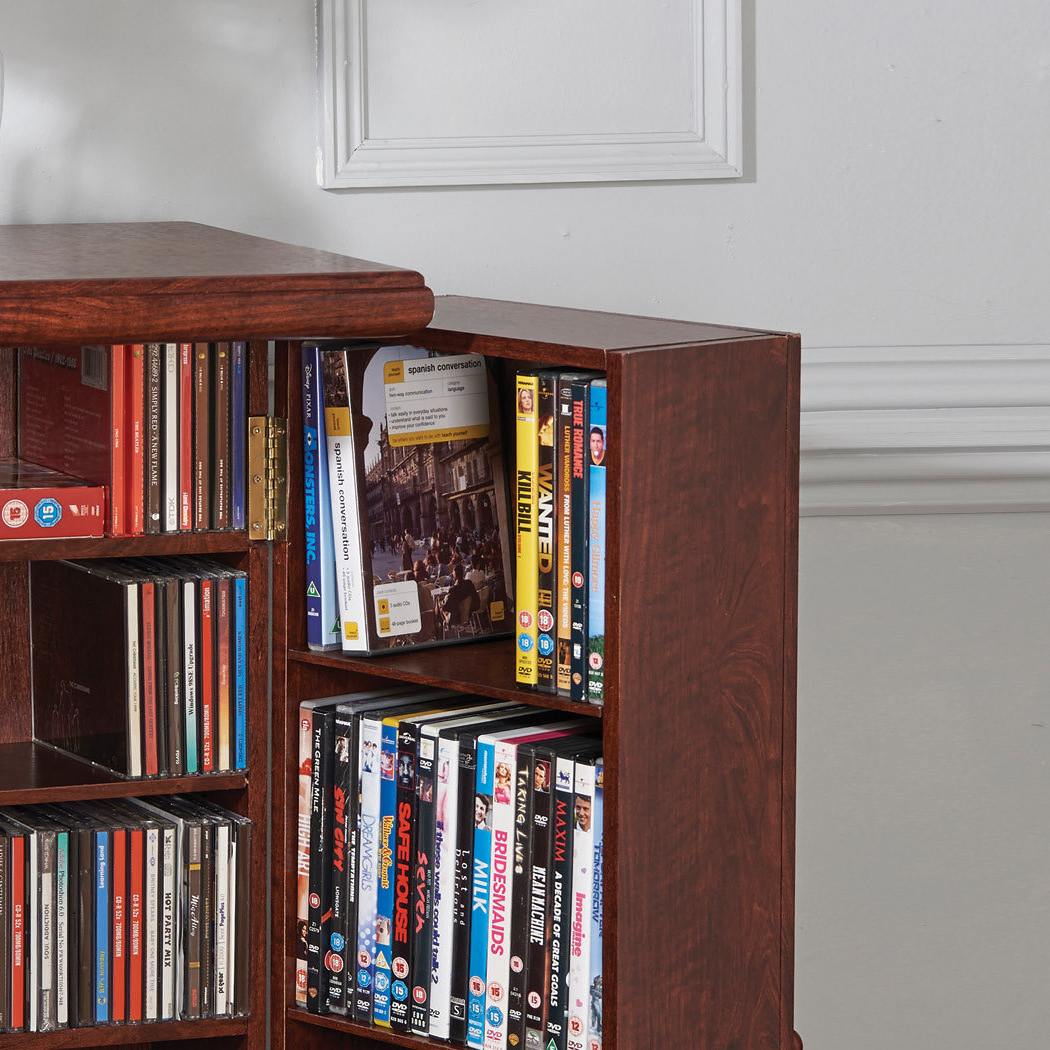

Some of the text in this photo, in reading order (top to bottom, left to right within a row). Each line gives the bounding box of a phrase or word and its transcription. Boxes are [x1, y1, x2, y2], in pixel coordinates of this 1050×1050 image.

[408, 359, 482, 377] spanish conversation
[334, 442, 345, 486] spanish
[572, 400, 583, 480] TRUE ROMANCE
[337, 488, 350, 562] conversation
[517, 470, 532, 534] KILL BILL
[538, 463, 553, 574] WANTED
[562, 494, 570, 515] FROM
[562, 516, 570, 542] LUTHER
[306, 532, 317, 565] INC.
[562, 543, 570, 559] WITH
[590, 500, 601, 593] Happy Gilmore
[561, 587, 569, 600] THE
[561, 602, 569, 629] VIDEOS
[187, 643, 195, 669] Upgrade
[312, 728, 322, 813] THE GREEN MILE
[297, 812, 311, 877] HIGH ART
[333, 785, 346, 873] SIN CITY
[360, 813, 376, 892] DREAMGIRLS
[381, 815, 394, 889] Wallace Gromit
[514, 765, 530, 875] TAKING LIVES
[395, 801, 411, 944] SAFE HOUSE
[414, 849, 429, 934] seven
[460, 848, 470, 893] Lost
[472, 857, 491, 914] MILK
[491, 829, 508, 957] BRIDESMAIDS
[530, 865, 547, 946] MEAN MACHINE
[550, 800, 567, 1007] MAXIM A DECADE OF GREAT GOALS
[592, 843, 602, 923] TOMORROW
[164, 892, 172, 968] HOT PARTY MIX
[432, 832, 444, 984] these walls could talk 2
[572, 892, 586, 958] Imagine
